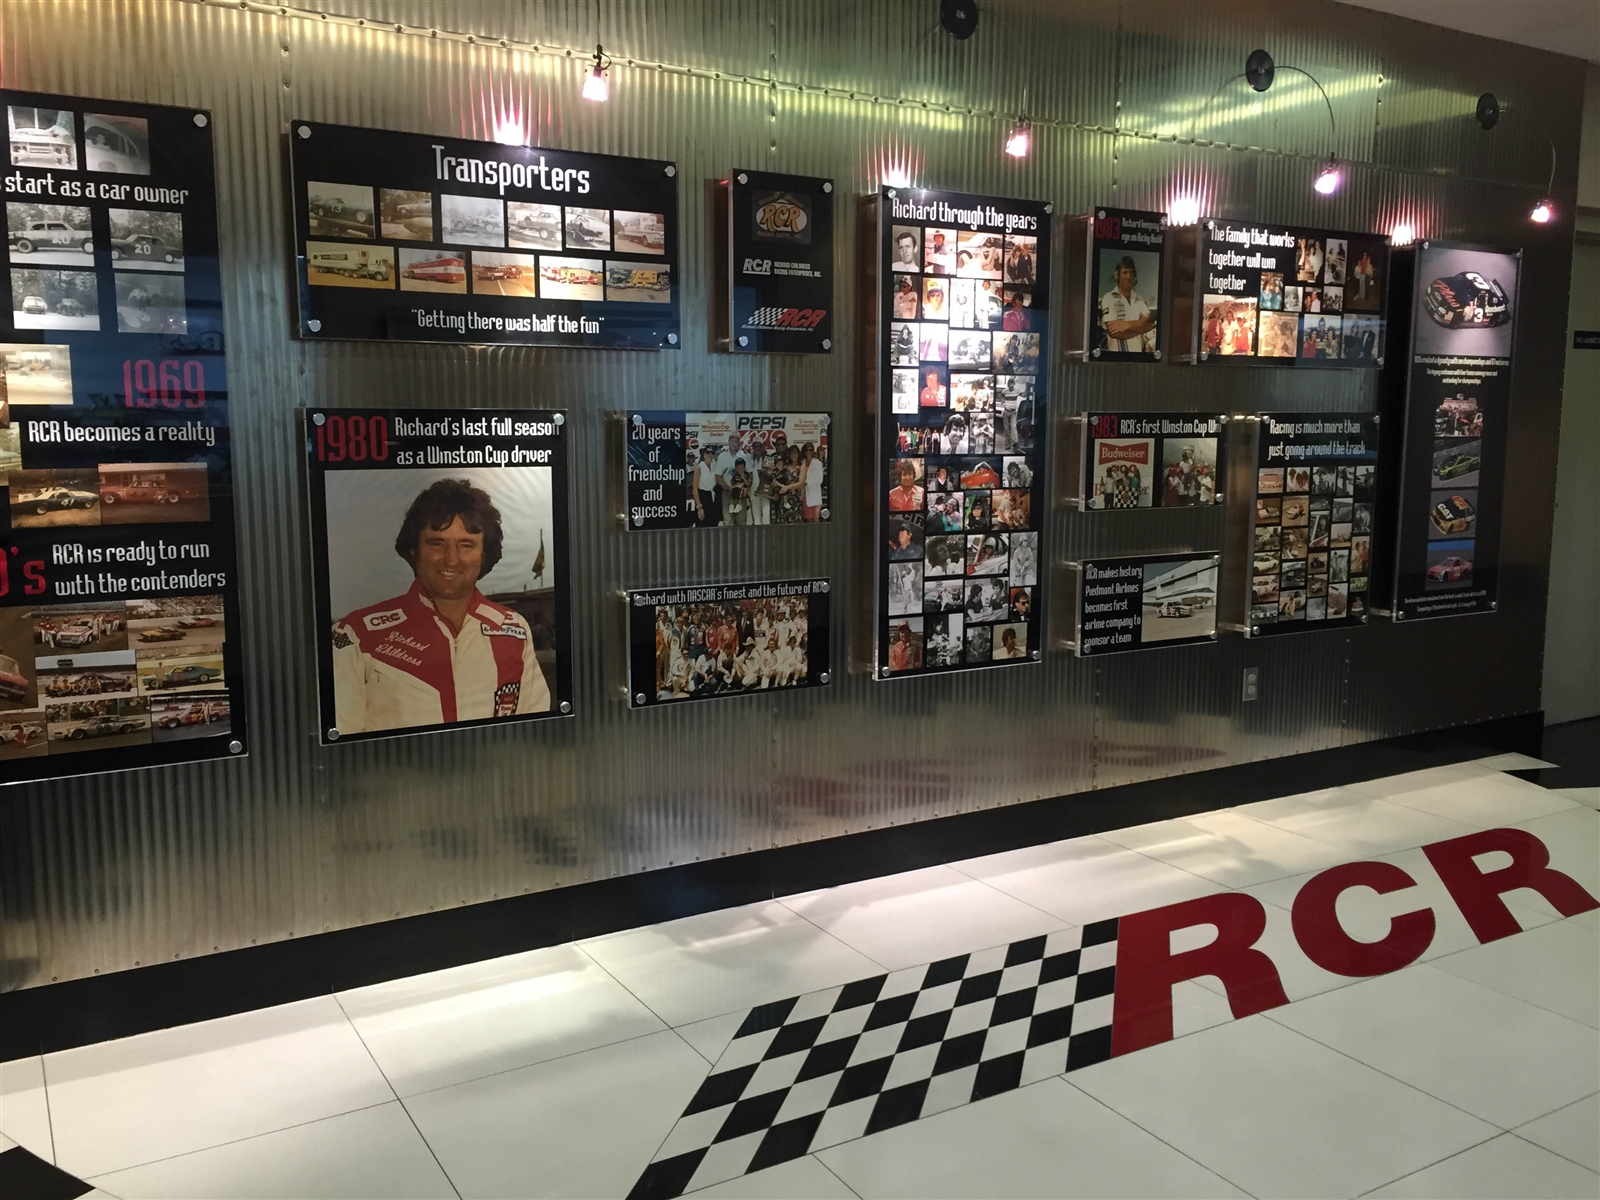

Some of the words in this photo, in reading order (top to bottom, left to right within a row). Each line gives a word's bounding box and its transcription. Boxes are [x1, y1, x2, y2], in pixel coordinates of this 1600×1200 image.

[432, 144, 590, 195] Transporters
[5, 171, 56, 195] start
[60, 180, 81, 198] as
[85, 182, 96, 198] a
[100, 183, 130, 200] car
[134, 186, 189, 205] owner
[759, 204, 801, 233] RCR
[892, 198, 937, 221] Richard
[939, 201, 984, 230] through
[985, 206, 1004, 227] the
[1006, 213, 1037, 233] years
[1211, 224, 1225, 242] The
[1226, 226, 1250, 248] family
[1251, 228, 1268, 246] that
[1269, 231, 1295, 248] works
[134, 244, 151, 255] 20
[1209, 248, 1246, 270] together
[1246, 252, 1261, 268] will
[1261, 257, 1276, 269] win
[743, 258, 772, 272] RCR
[1209, 273, 1246, 294] together
[1466, 273, 1490, 290] 3
[467, 311, 503, 330] there
[505, 317, 532, 332] was
[533, 314, 556, 333] half
[557, 315, 578, 333] the
[776, 308, 826, 328] RCR
[1474, 308, 1483, 323] 3
[123, 359, 205, 409] 1969
[28, 420, 61, 443] RCR
[63, 421, 141, 442] becomes
[144, 427, 155, 442] a
[158, 421, 215, 446] reality
[395, 417, 460, 437] Richard's
[462, 417, 489, 436] last
[491, 417, 512, 436] full
[514, 420, 560, 436] season
[738, 416, 787, 430] PEPSI
[1120, 419, 1141, 434] RCR's
[1142, 419, 1160, 434] first
[1162, 419, 1192, 434] Winston
[1194, 419, 1207, 437] Cup
[1269, 419, 1294, 438] Racing
[1295, 424, 1302, 434] is
[1303, 419, 1323, 434] much
[1324, 422, 1342, 434] more
[1344, 419, 1361, 434] than
[317, 415, 389, 462] 1980
[632, 424, 646, 440] 20
[648, 427, 681, 445] years
[397, 451, 413, 465] as
[416, 451, 425, 464] a
[427, 445, 482, 464] Winston
[485, 445, 508, 467] Cup
[511, 445, 552, 463] driver
[649, 446, 661, 463] of
[1101, 446, 1145, 459] Budweiser
[1268, 441, 1284, 460] just
[1285, 444, 1305, 460] going
[1306, 441, 1332, 455] around
[1333, 440, 1344, 455] the
[1345, 440, 1366, 455] track
[628, 465, 685, 485] friendship
[643, 484, 663, 501] and
[631, 504, 677, 519] success
[1437, 503, 1455, 519] CAT
[52, 544, 84, 565] RCR
[87, 549, 102, 563] is
[106, 541, 156, 566] ready
[159, 540, 177, 560] to
[180, 544, 210, 559] run
[1098, 567, 1119, 579] makes
[1120, 565, 1142, 579] history
[55, 573, 95, 596] with
[98, 572, 127, 593] the
[131, 569, 226, 591] contenders
[1085, 583, 1115, 597] Piedmont
[1115, 582, 1139, 594] Airlines
[634, 591, 665, 606] Rhard
[667, 590, 686, 604] with
[687, 588, 722, 602] NASCAR's
[723, 585, 746, 600] finest
[748, 585, 761, 598] and
[763, 583, 775, 596] the
[777, 582, 802, 595] future
[803, 581, 812, 594] of
[813, 581, 826, 593] RC
[1085, 601, 1112, 614] becomes
[1113, 599, 1128, 611] first
[370, 612, 402, 627] CRC
[1084, 617, 1105, 630] airline
[1106, 616, 1133, 630] company
[1134, 614, 1141, 626] to
[385, 630, 431, 652] Richard
[1084, 635, 1110, 648] sponsor
[1115, 633, 1132, 644] team
[375, 643, 422, 667] Childress
[1110, 828, 1600, 1059] RCR
